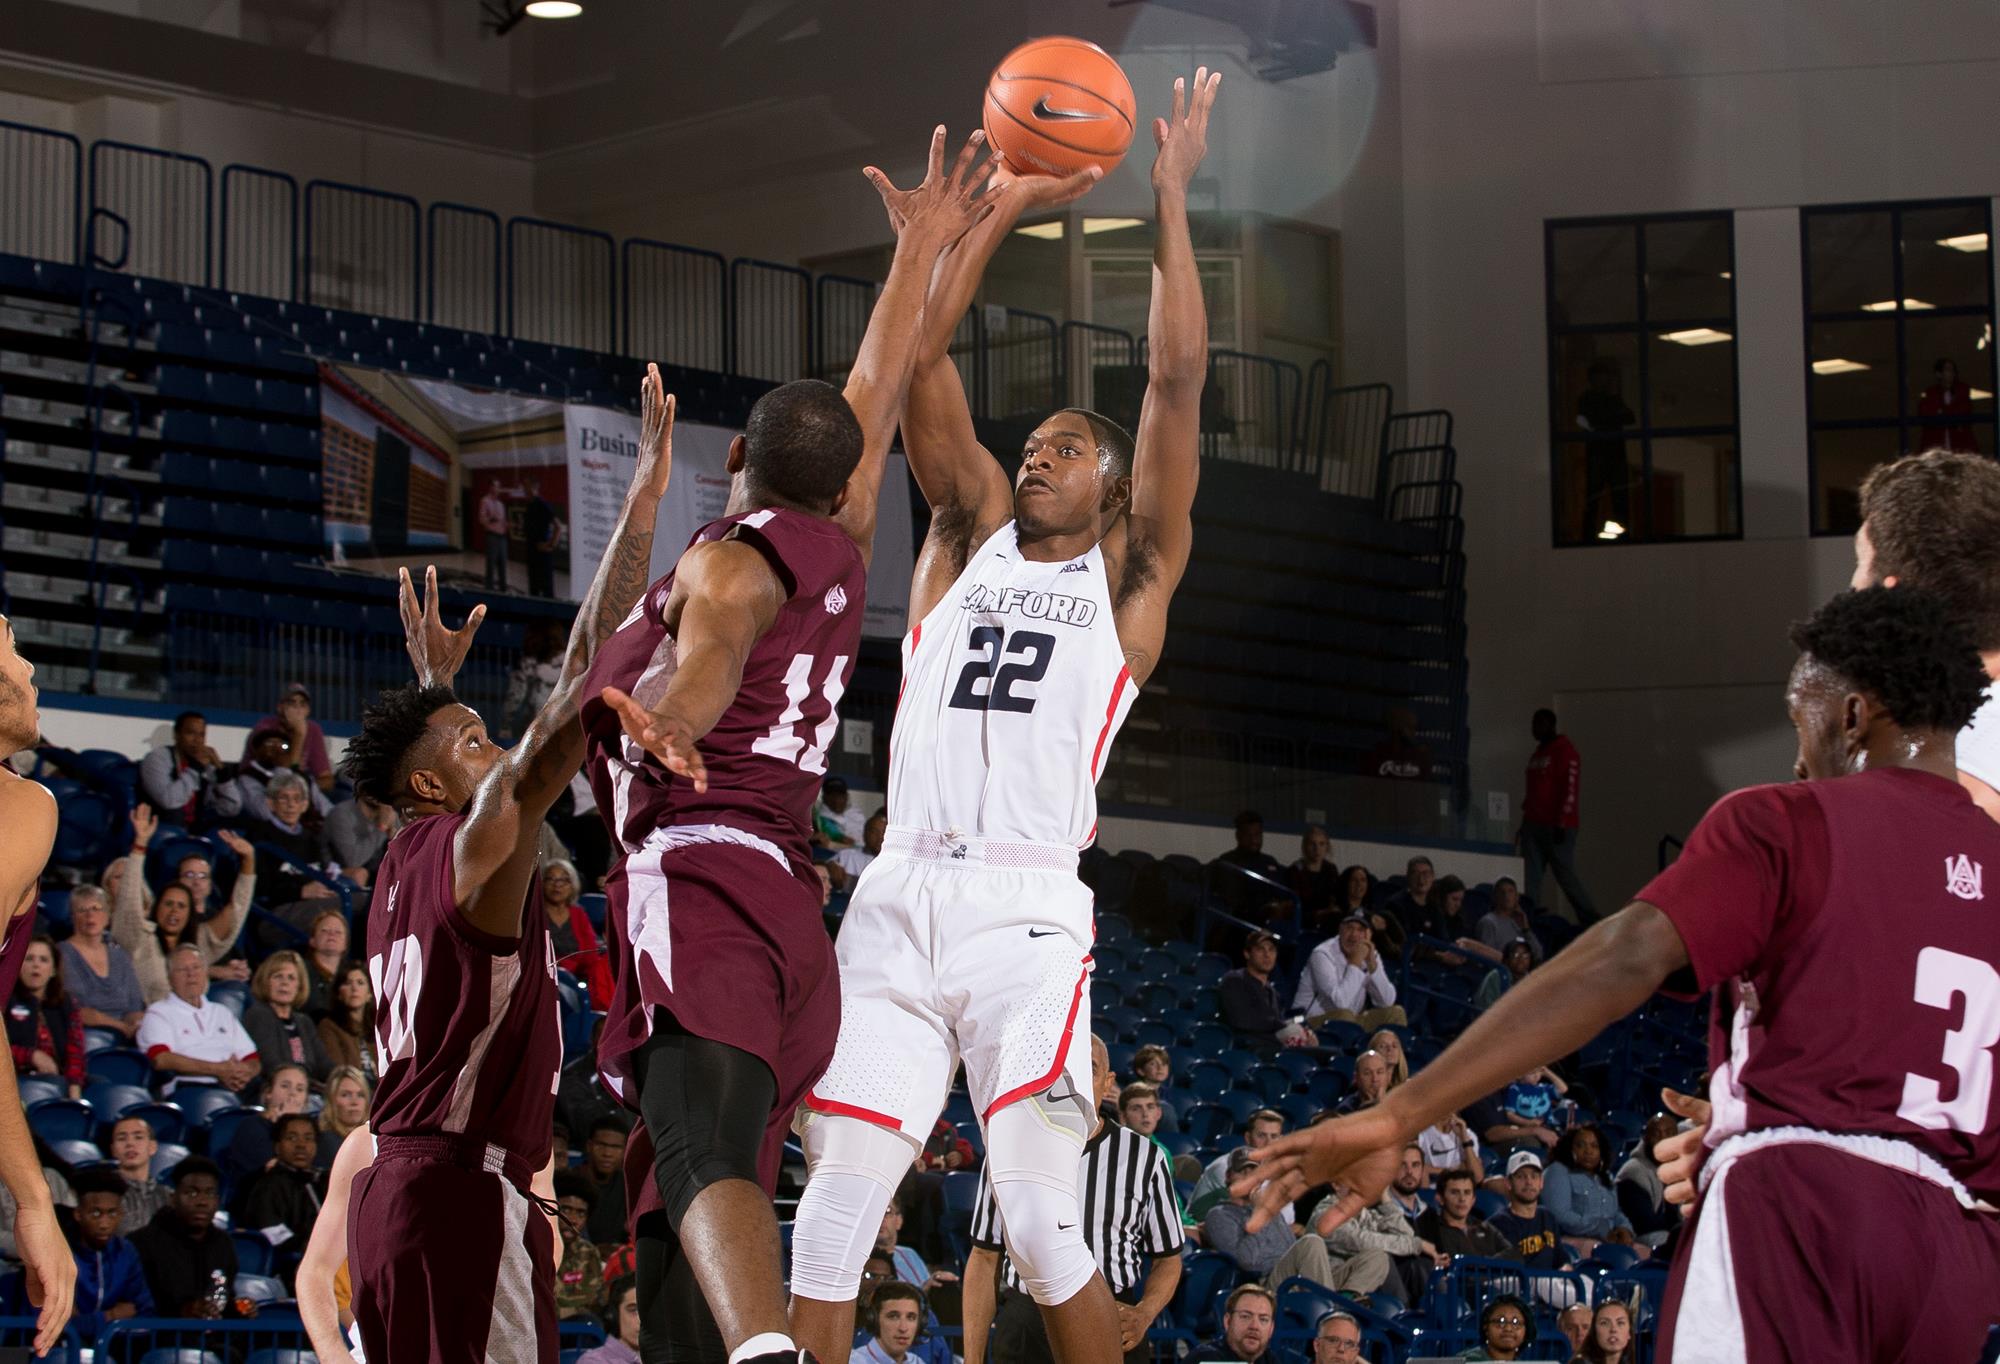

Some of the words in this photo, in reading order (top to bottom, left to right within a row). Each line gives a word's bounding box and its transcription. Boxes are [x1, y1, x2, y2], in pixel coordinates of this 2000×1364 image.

[751, 653, 849, 776] 11
[948, 626, 1056, 714] 22
[1896, 946, 2000, 1136] 3
